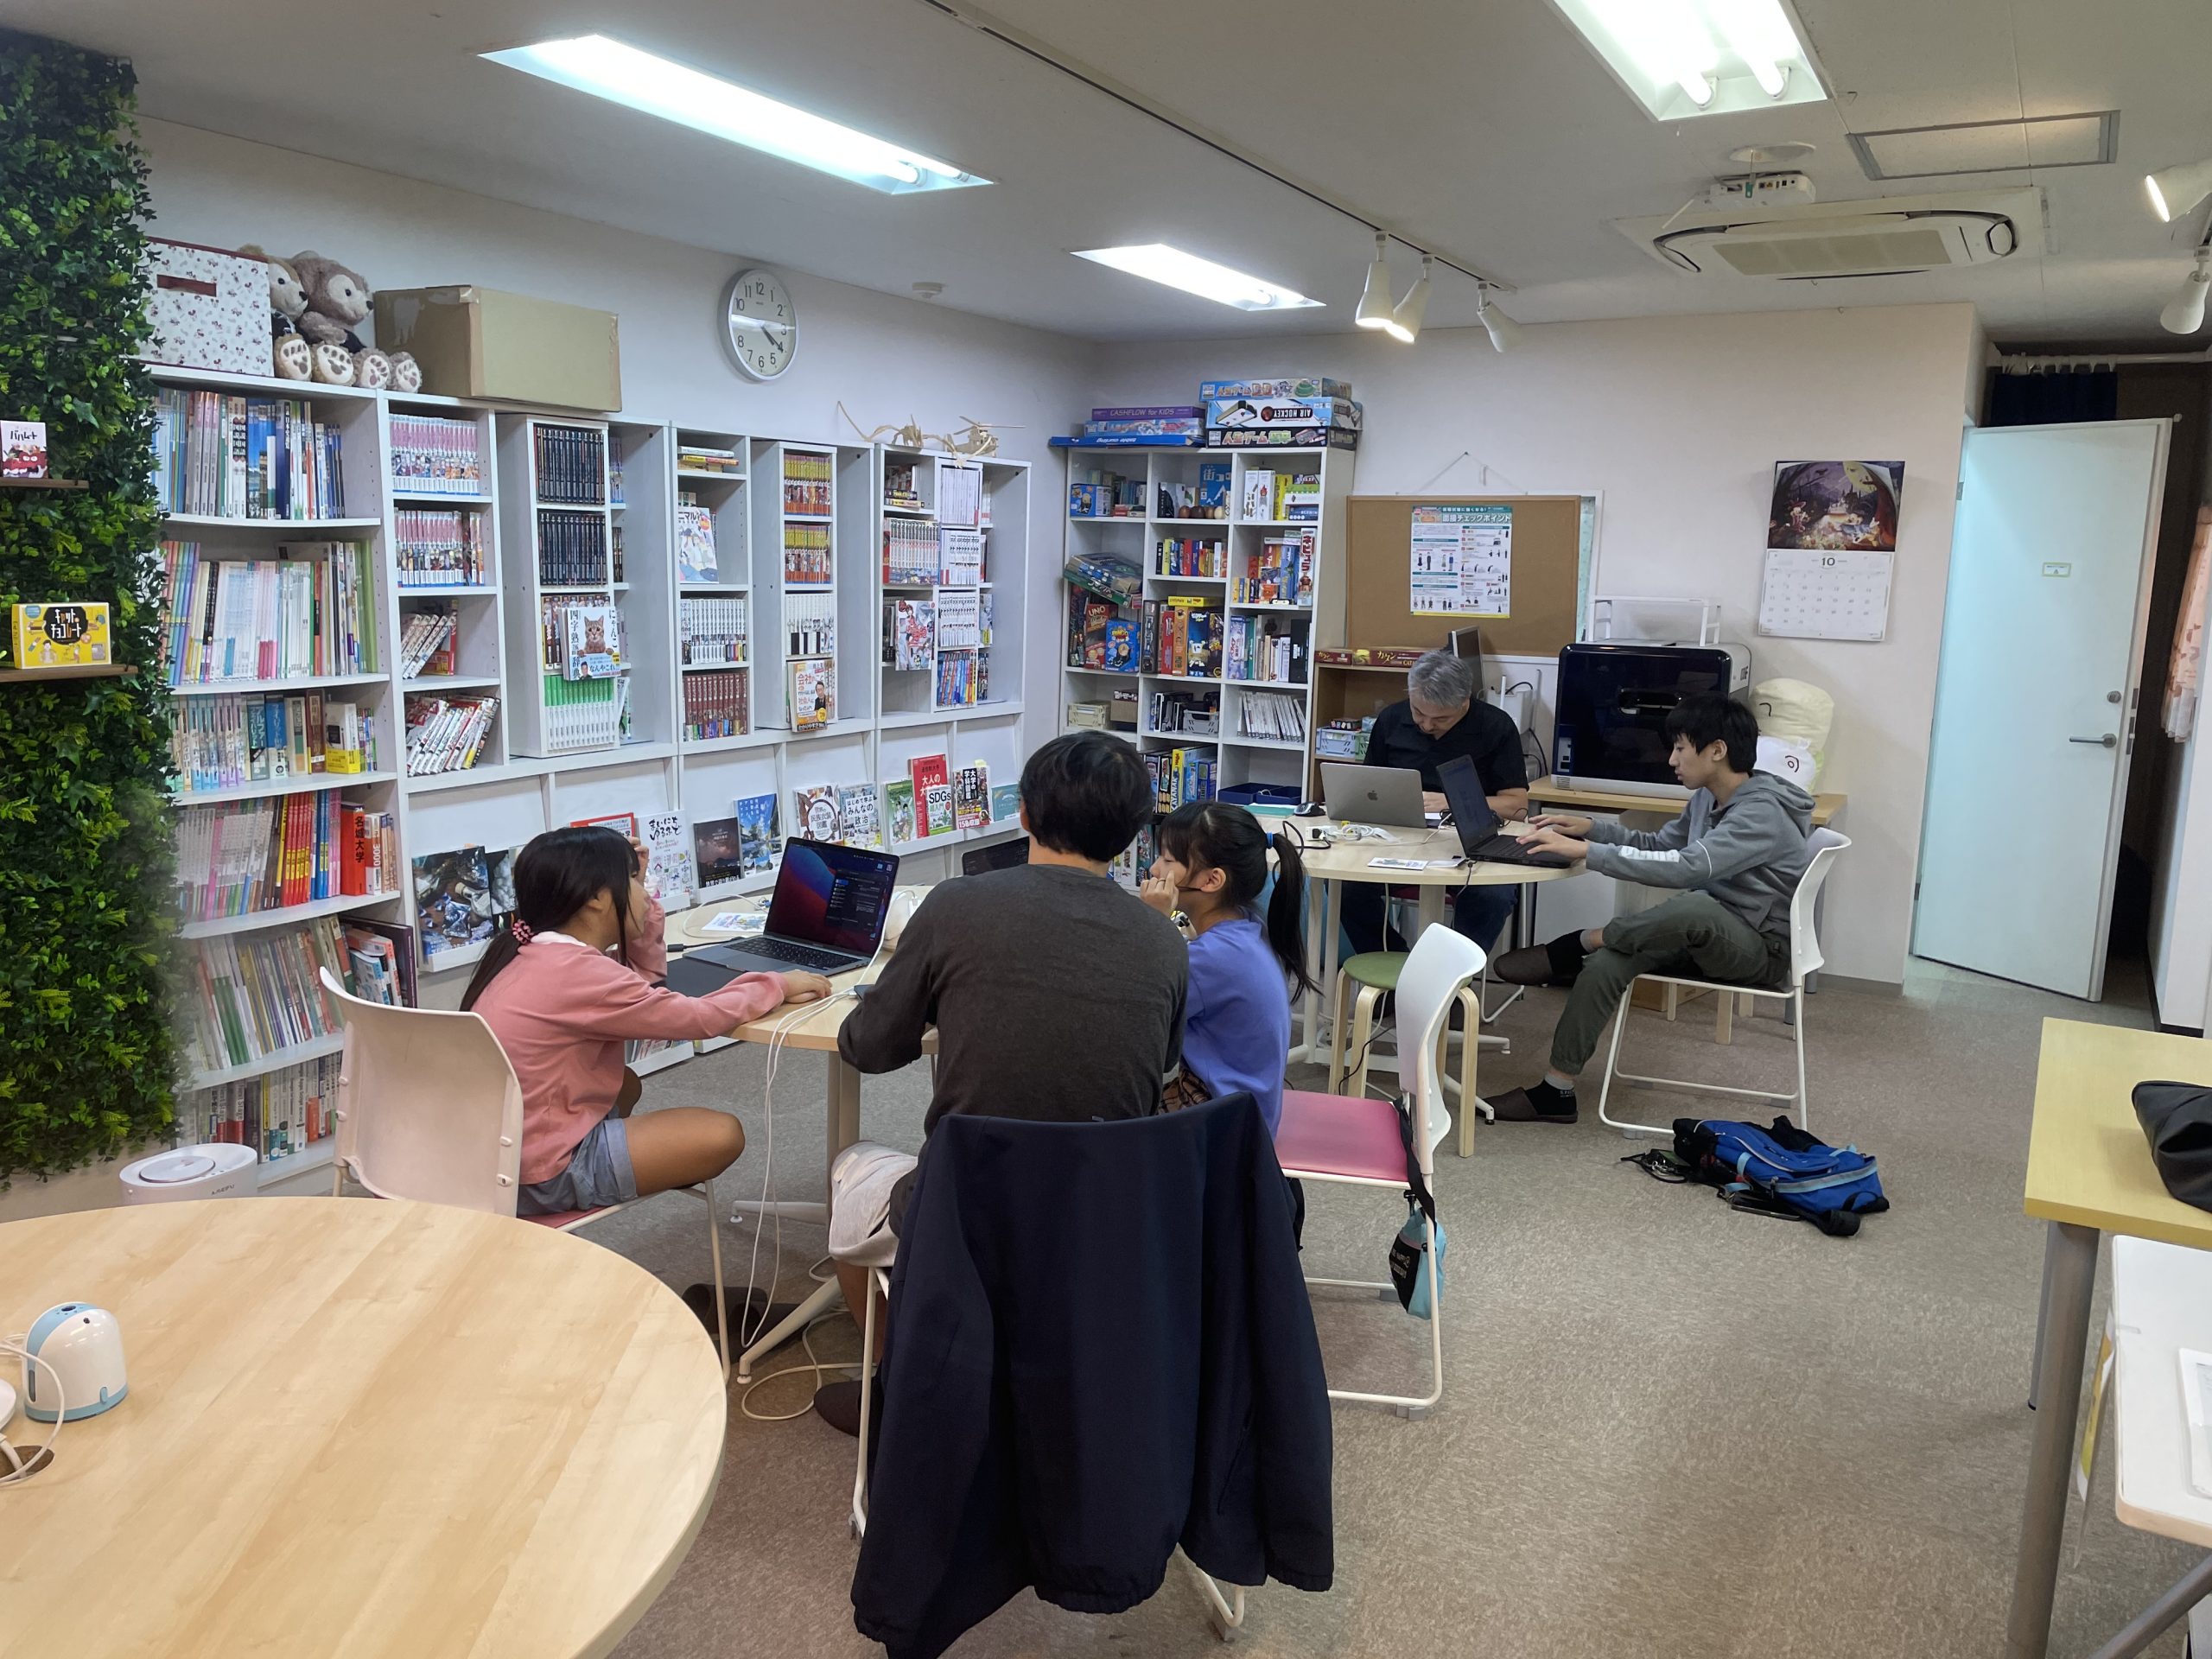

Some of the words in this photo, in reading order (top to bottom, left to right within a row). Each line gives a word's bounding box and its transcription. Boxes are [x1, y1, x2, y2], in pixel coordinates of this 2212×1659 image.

[745, 285, 751, 298] 11
[756, 283, 765, 295] 12
[770, 290, 773, 302] 1
[736, 298, 745, 310] 10
[778, 304, 783, 316] 2
[781, 323, 786, 335] 3
[738, 335, 744, 347] 8
[747, 350, 753, 361] 7
[770, 353, 776, 365] 5
[759, 356, 764, 368] 6
[1274, 409, 1298, 417] HOCKEY
[1300, 409, 1312, 417] AIR
[1222, 430, 1268, 445] 人生ゲーム
[1442, 514, 1510, 523] 面接チェックポイント
[1821, 557, 1836, 566] 10
[1088, 606, 1106, 617] UNO
[51, 622, 82, 639] チョコレート
[569, 609, 582, 679] 四字熟語辞典
[922, 773, 941, 785] 大人の
[847, 796, 873, 806] はじめて学ぶ
[929, 791, 951, 804] SDGs
[848, 804, 874, 816] みんなの
[649, 816, 678, 831] まいにち
[855, 815, 869, 826] 政治
[355, 816, 365, 863] 名城大学
[372, 843, 381, 867] 3000
